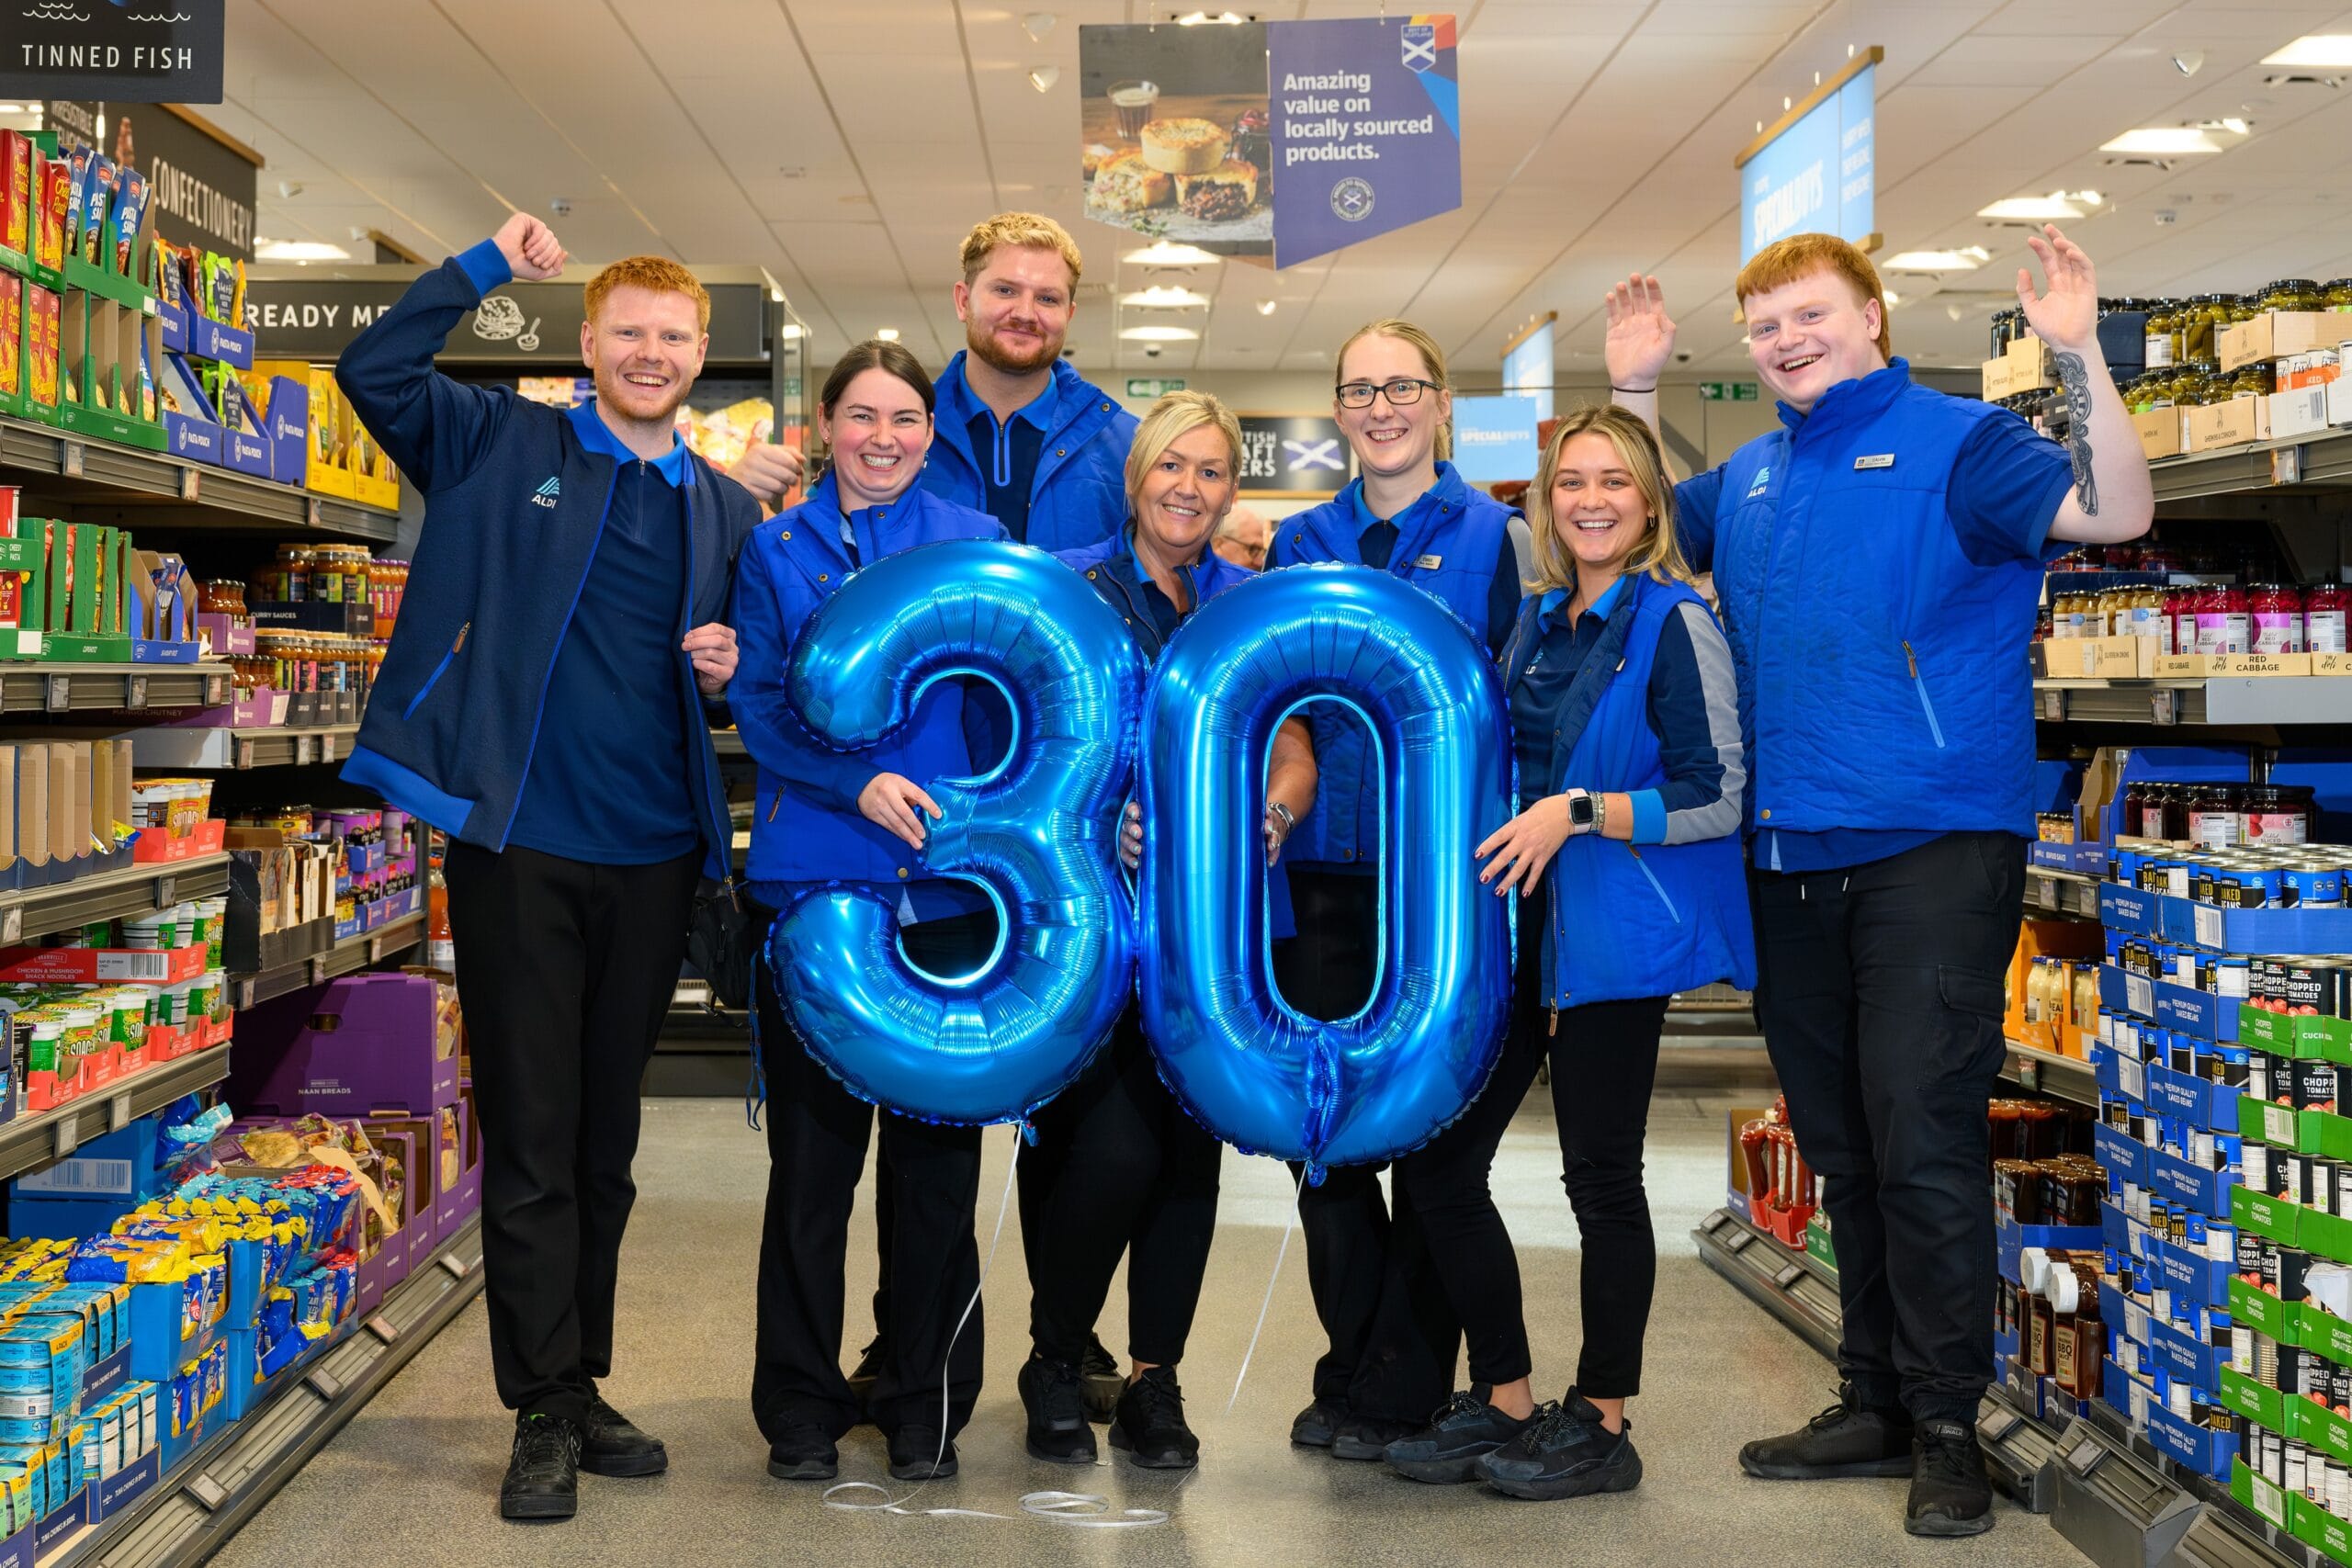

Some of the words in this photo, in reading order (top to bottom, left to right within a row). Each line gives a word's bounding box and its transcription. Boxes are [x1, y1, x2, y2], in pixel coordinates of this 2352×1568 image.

[22, 44, 120, 69] TINNED
[134, 46, 193, 70] FISH
[1283, 70, 1372, 94] Amazing
[1283, 96, 1340, 115] value
[1344, 98, 1371, 113] on
[1284, 118, 1350, 141] locally
[1353, 115, 1433, 136] sourced
[1285, 141, 1380, 166] products.
[152, 155, 253, 253] CONFECTIONERY
[247, 304, 339, 328] READY
[1244, 431, 1277, 445] TISH
[1241, 442, 1276, 460] AFT
[1239, 459, 1277, 477] ERS
[1747, 485, 1768, 498] ALDI
[531, 493, 557, 509] ALDI
[1525, 665, 1537, 675] LD
[2287, 981, 2322, 992] CHOPPED
[2288, 991, 2319, 999] TOMATOES
[2255, 1018, 2272, 1030] CHOPPED
[2255, 1027, 2273, 1040] TOMATOES
[2302, 1077, 2335, 1087] CHOPP
[2252, 1201, 2271, 1215] CHOPPED
[2251, 1211, 2272, 1226] TOMATOES
[2171, 1223, 2186, 1235] BAK
[2247, 1295, 2264, 1310] CHOPPED
[2246, 1305, 2265, 1321] TOMATOES
[2057, 1342, 2073, 1357] BBQ
[2241, 1386, 2259, 1402] CHOPPED
[2240, 1395, 2260, 1412] TOMATOES
[2329, 1423, 2347, 1439] CHOPPED
[2328, 1432, 2349, 1451] TOMATOES
[2326, 1524, 2346, 1541] CHOPPED
[2324, 1533, 2347, 1552] TOMATOES
